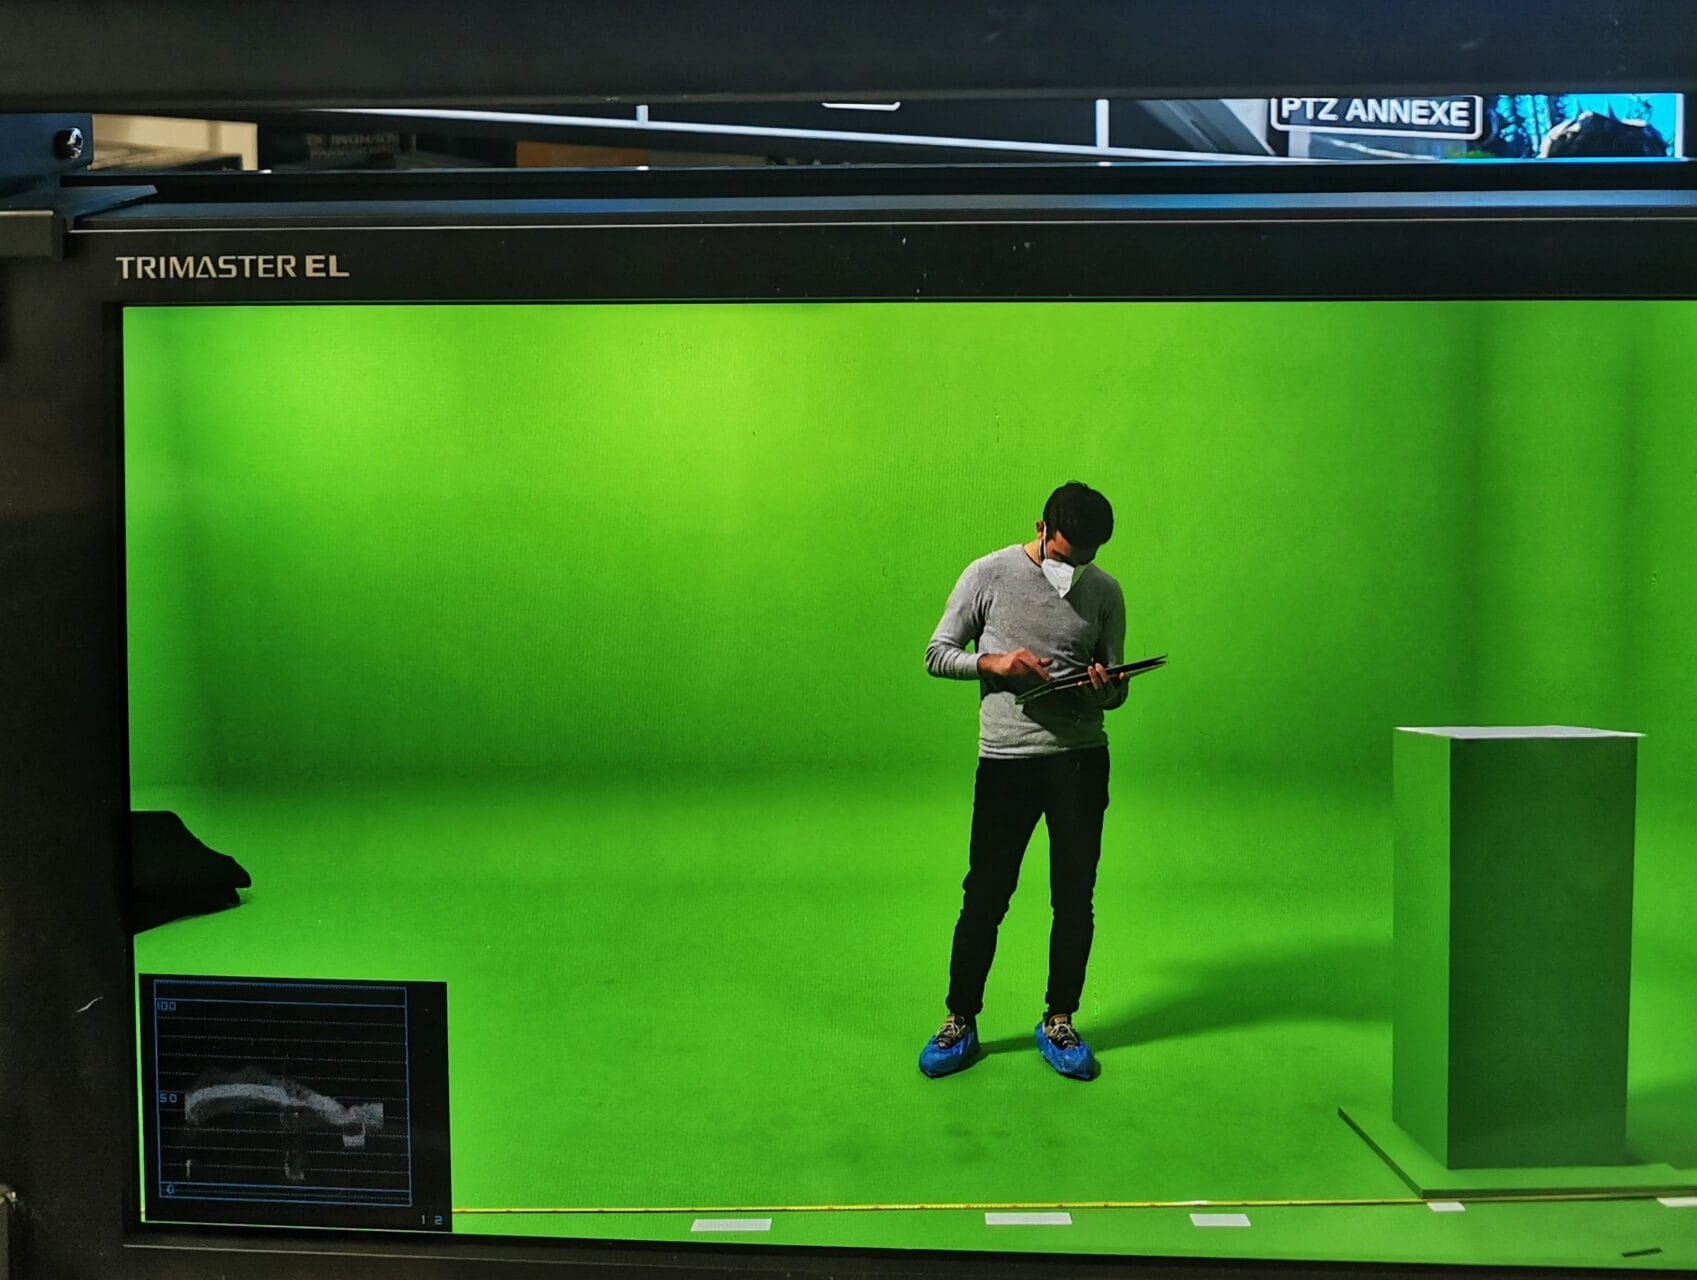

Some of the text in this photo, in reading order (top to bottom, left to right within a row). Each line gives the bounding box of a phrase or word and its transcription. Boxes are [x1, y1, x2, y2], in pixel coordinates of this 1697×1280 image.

[1281, 98, 1471, 127] PTZ ANNEXE
[115, 254, 350, 280] TRIMASTER EL
